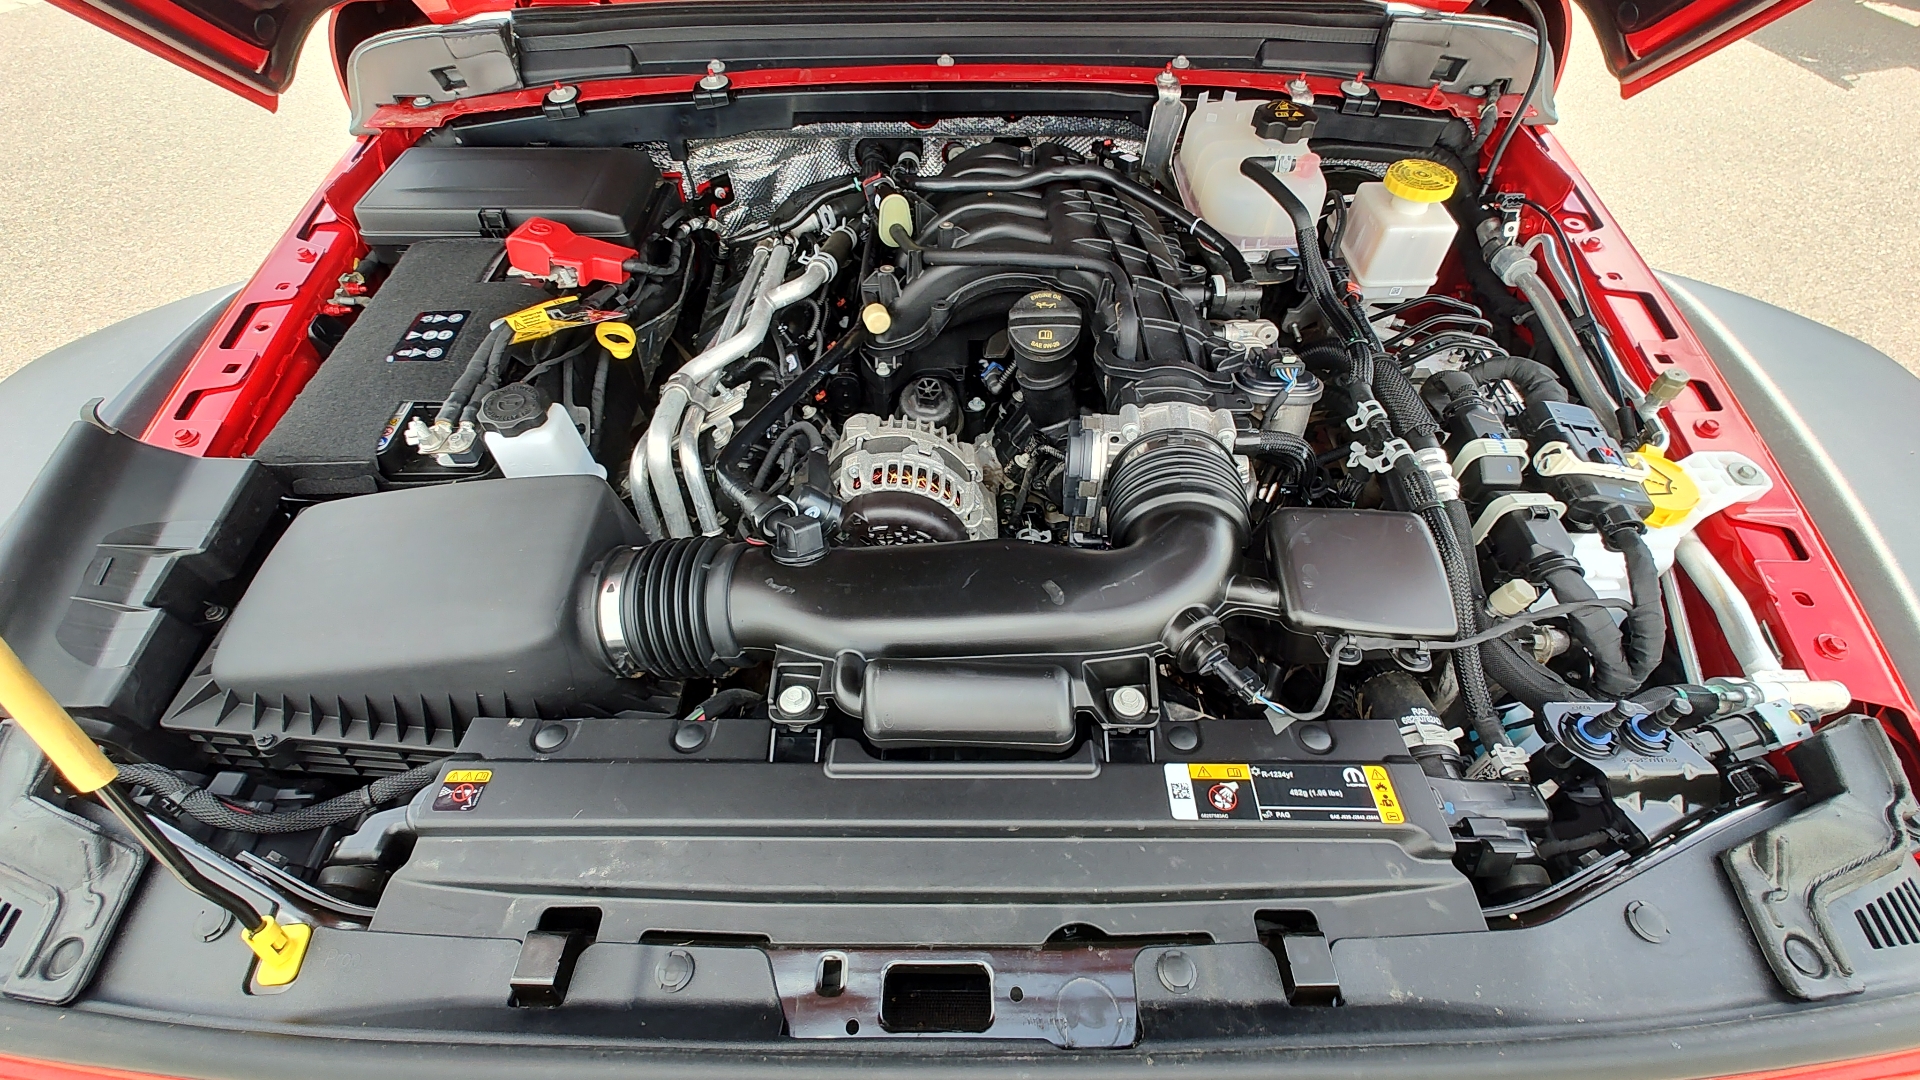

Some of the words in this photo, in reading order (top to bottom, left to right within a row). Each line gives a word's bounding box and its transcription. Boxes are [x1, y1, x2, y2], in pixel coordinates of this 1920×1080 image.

[1030, 293, 1052, 301] ENGINE
[1052, 293, 1062, 301] OIL
[1030, 340, 1042, 348] SAE
[1411, 707, 1429, 715] RAD
